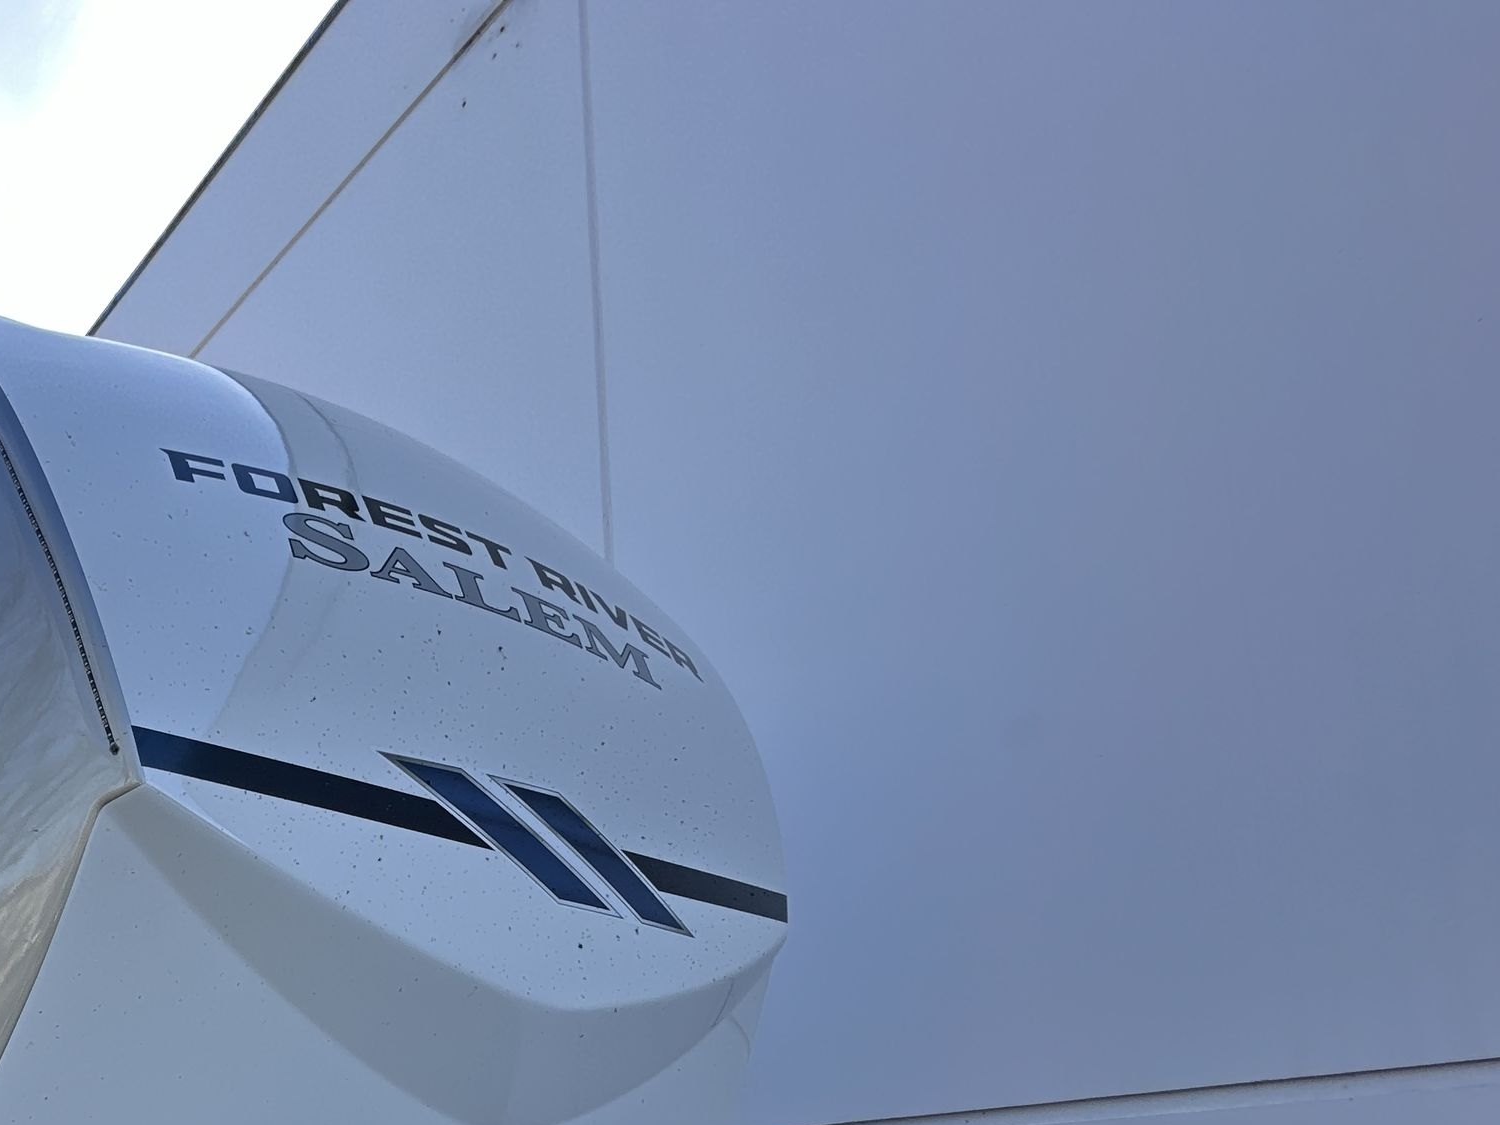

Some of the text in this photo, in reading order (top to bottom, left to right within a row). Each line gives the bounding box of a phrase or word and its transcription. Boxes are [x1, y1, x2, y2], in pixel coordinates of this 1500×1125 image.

[159, 447, 705, 683] FOREST RIVER
[282, 512, 662, 690] SALEM
